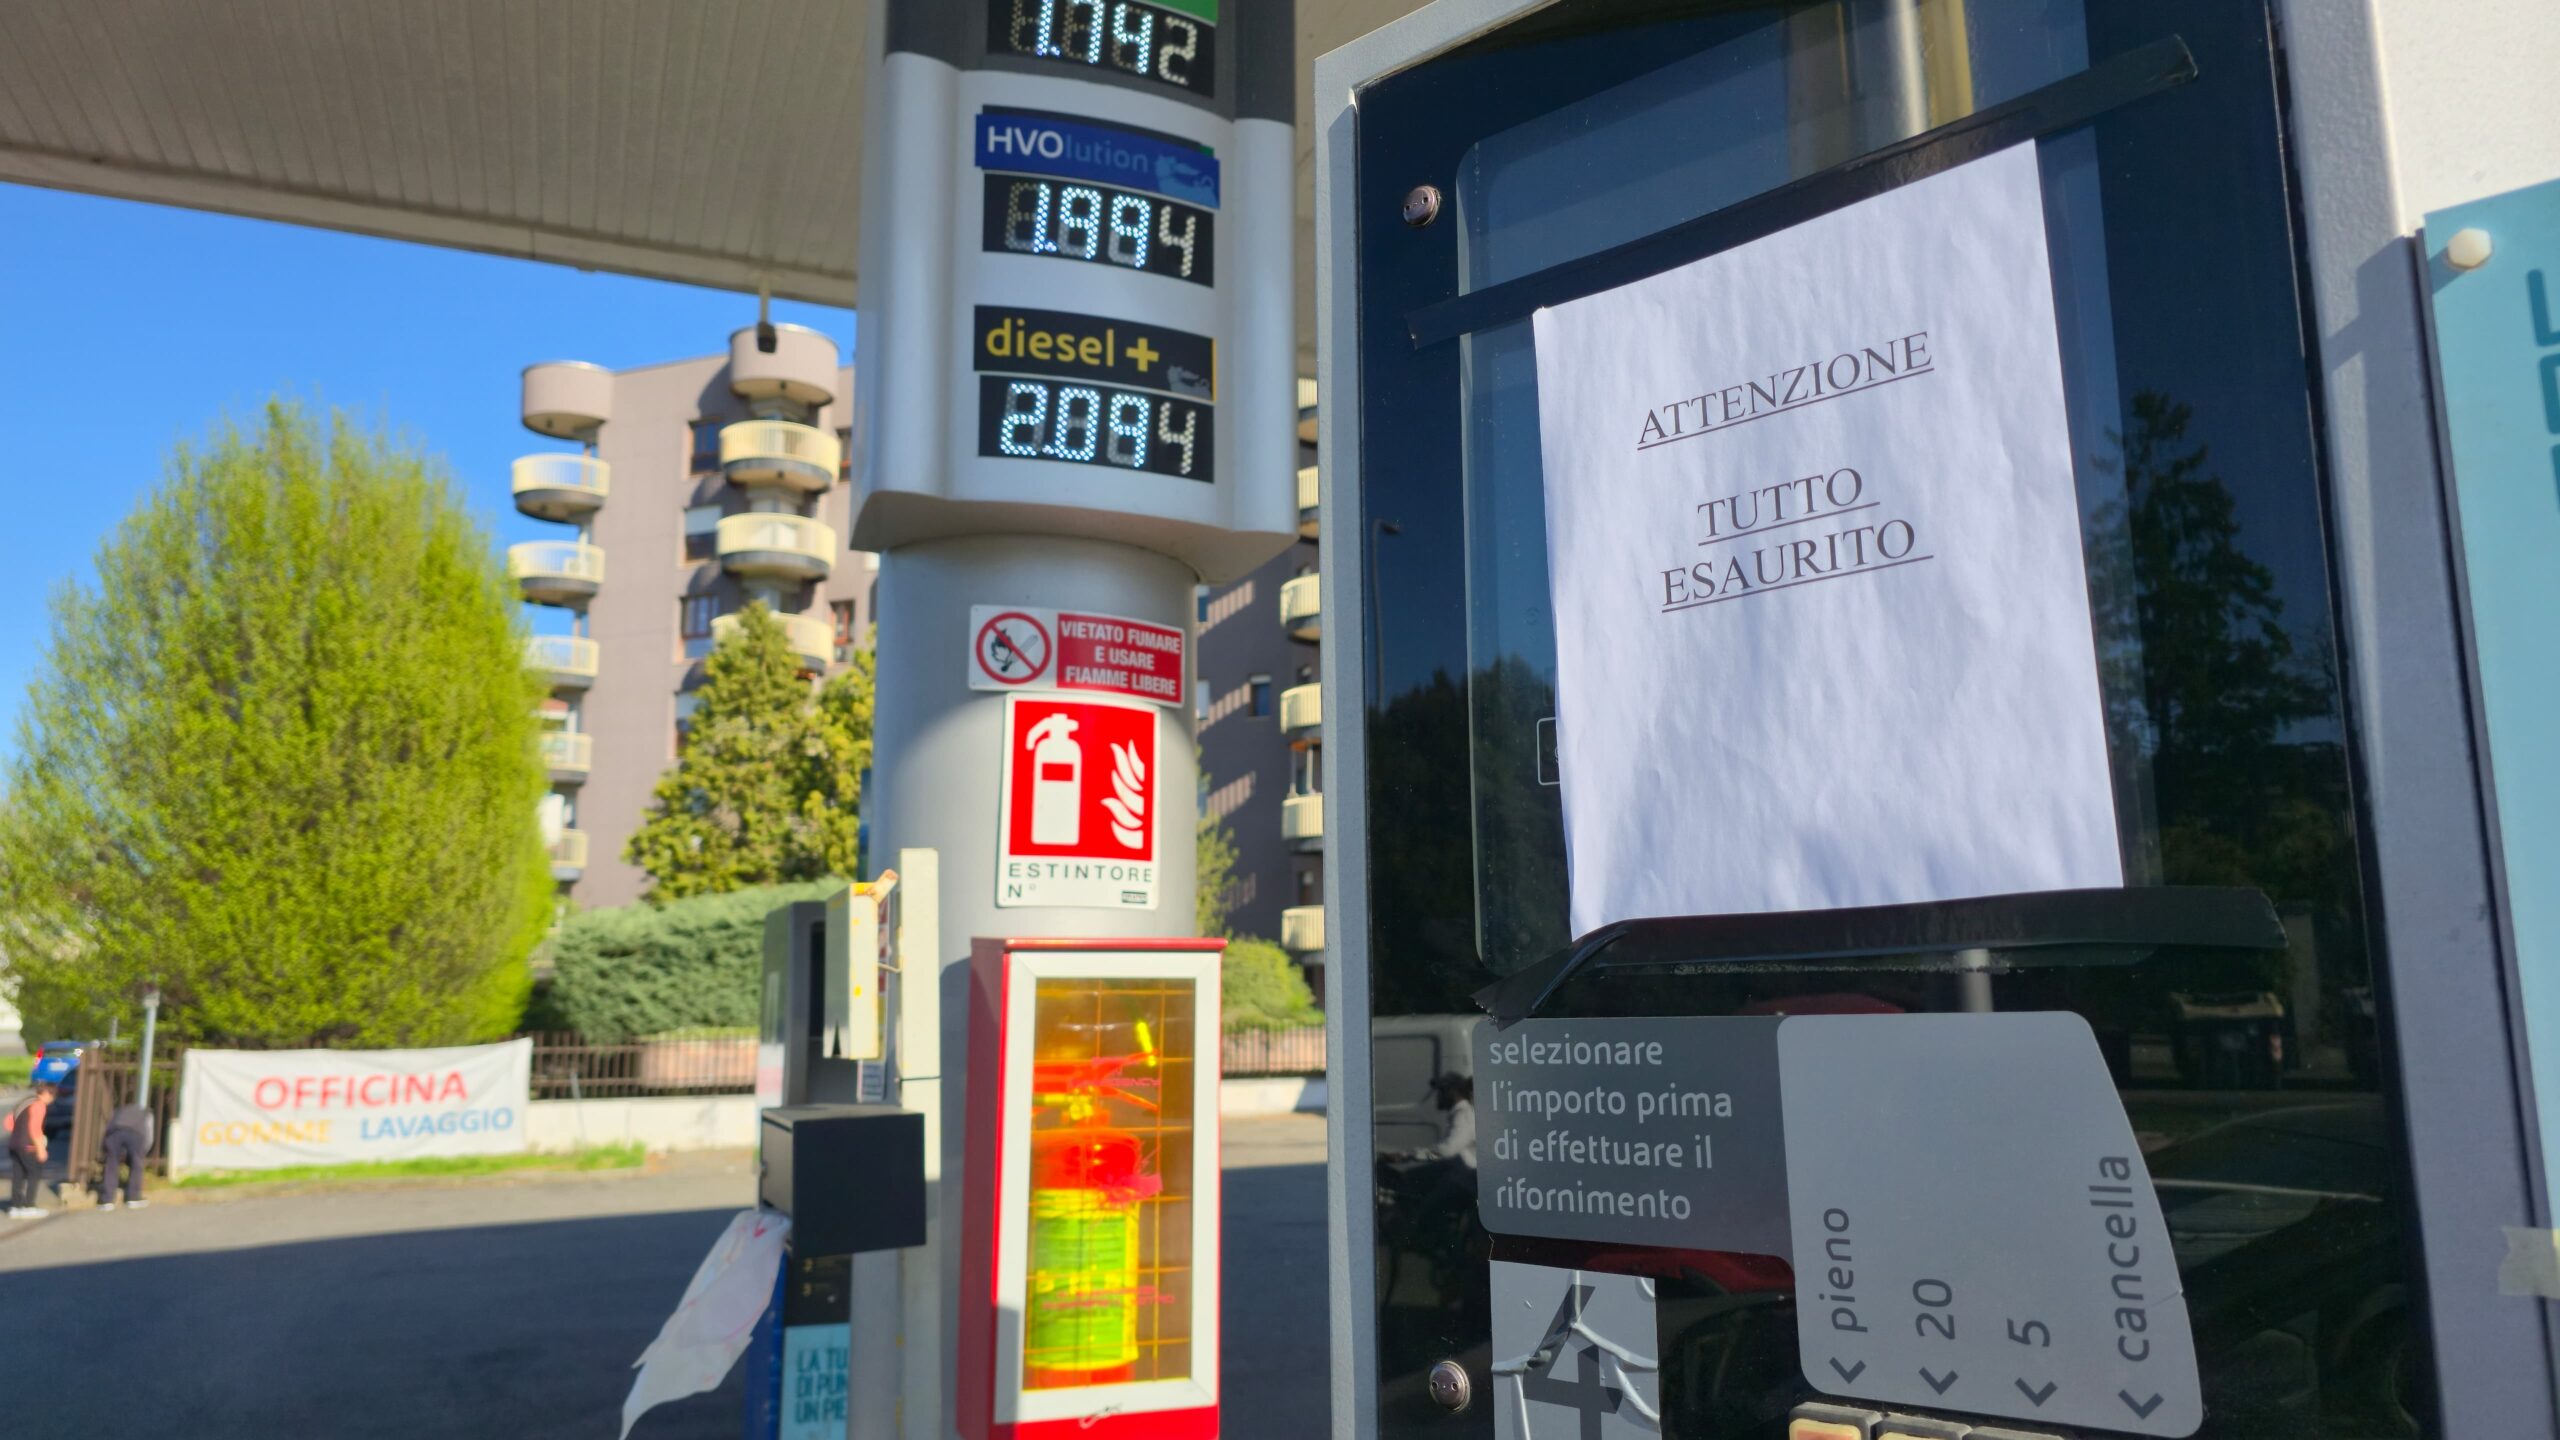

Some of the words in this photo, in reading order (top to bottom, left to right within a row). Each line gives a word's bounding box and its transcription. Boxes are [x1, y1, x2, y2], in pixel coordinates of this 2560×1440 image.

[987, 125, 1149, 174] HVOlution
[1033, 183, 1196, 278] 1.994
[985, 317, 1115, 368] diesel
[1637, 331, 1933, 446] ATTENZIONE
[1000, 382, 1196, 475] 2.094
[1697, 467, 1863, 538] TUTTO
[1660, 518, 1916, 607] ESAURITO
[1060, 620, 1124, 643] VIETATO
[1128, 628, 1181, 654] FUMARE
[1094, 645, 1105, 663] E
[1109, 647, 1155, 671] USARE
[1065, 665, 1129, 688] FIAMME
[1131, 672, 1177, 697] LIBERE
[1008, 862, 1153, 882] ESTINTORE
[1489, 1033, 1663, 1065] selezionare
[253, 1071, 469, 1111] OFFICINA
[1491, 1080, 1627, 1121] l'importo
[1636, 1082, 1733, 1124] prima
[198, 1119, 334, 1146] GOMME
[359, 1106, 515, 1141] LAVAGGIO
[1493, 1128, 1519, 1161] di
[1528, 1130, 1684, 1168] effettuare
[1694, 1134, 1713, 1169] il
[1496, 1176, 1692, 1221] rifornimento
[1818, 1206, 1869, 1334] pieno
[2087, 1155, 2151, 1362] cancella
[1911, 1278, 1956, 1340] 20
[2006, 1317, 2051, 1348] 5
